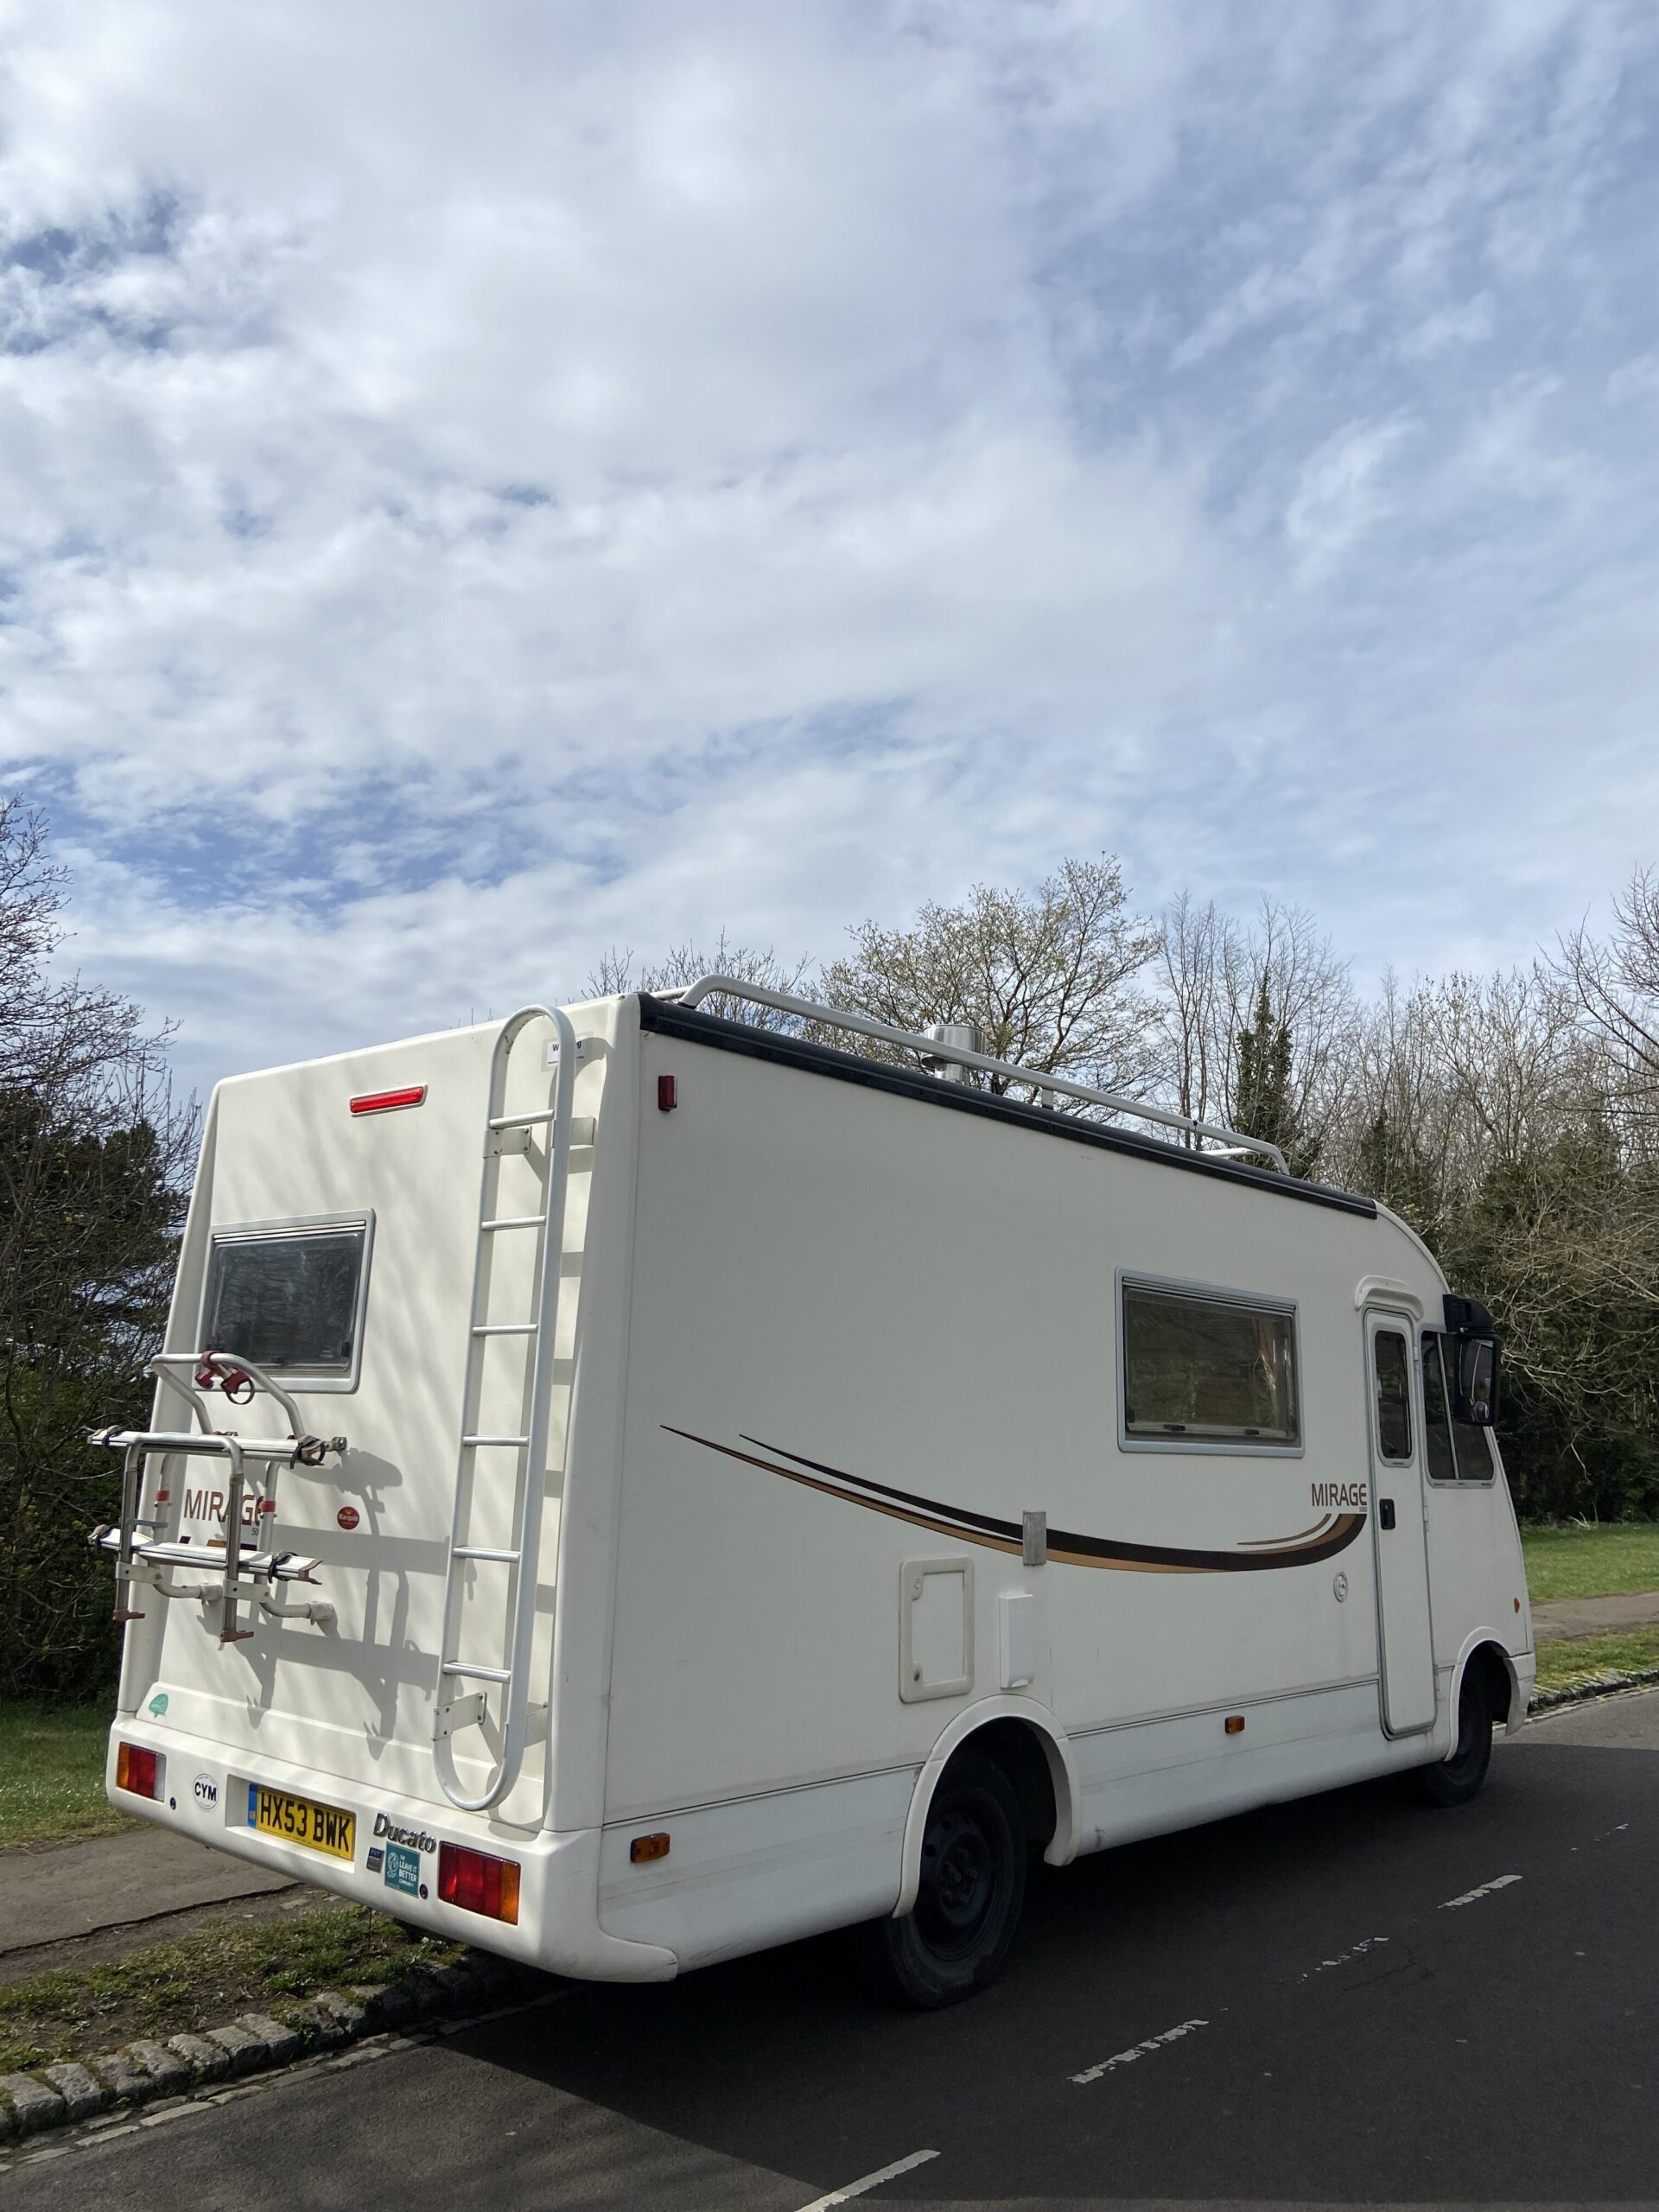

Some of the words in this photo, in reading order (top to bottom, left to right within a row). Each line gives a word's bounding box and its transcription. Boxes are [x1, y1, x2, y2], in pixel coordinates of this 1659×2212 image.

[1311, 1483, 1367, 1506] MIRAGE
[194, 1781, 217, 1802] CYM
[260, 1792, 308, 1837] HX53
[312, 1808, 350, 1852] BWK
[373, 1813, 437, 1853] Ducato
[398, 1868, 417, 1883] BETTER
[399, 1860, 413, 1872] LEAVE
